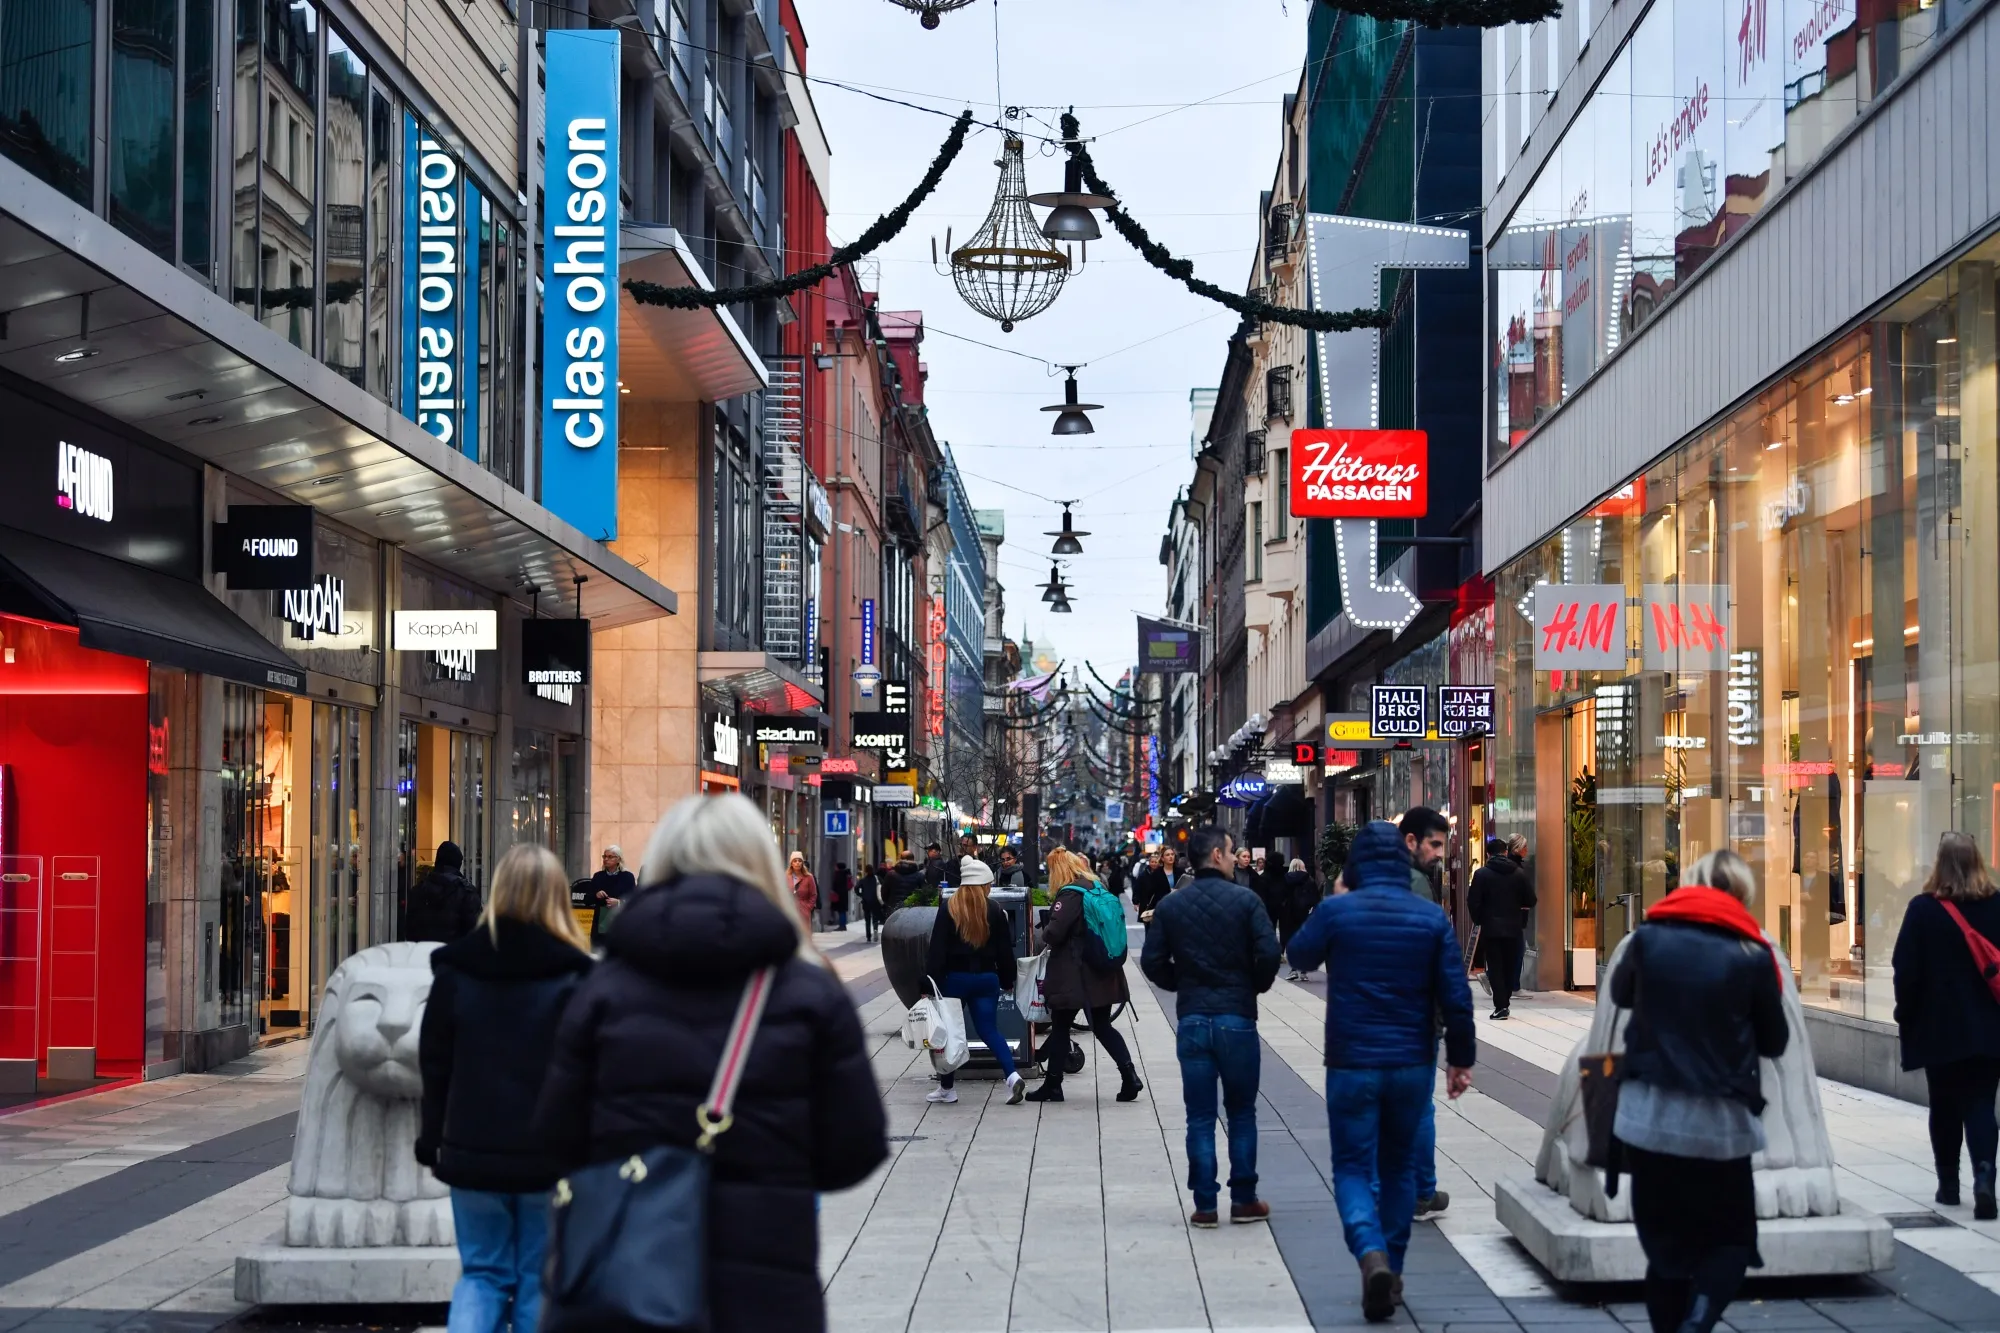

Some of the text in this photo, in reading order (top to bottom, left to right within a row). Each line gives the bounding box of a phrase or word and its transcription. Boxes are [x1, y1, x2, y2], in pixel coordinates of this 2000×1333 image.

[1646, 76, 1708, 187] Let's remake
[552, 117, 607, 448] clas ohlson
[1301, 442, 1420, 486] Hötorgs
[57, 440, 114, 522] AFOUND
[242, 538, 299, 557] AFOUND
[408, 621, 478, 638] KappAhl
[864, 600, 872, 664] RESTAURANG
[1542, 602, 1618, 654] H&M
[528, 670, 582, 683] BROTHERS
[931, 598, 946, 736] APOTEK
[1378, 692, 1418, 704] HALL
[756, 727, 816, 742] stadium
[1377, 720, 1420, 732] GULD
[855, 735, 904, 747] SCORETT
[1235, 782, 1265, 792] SALT
